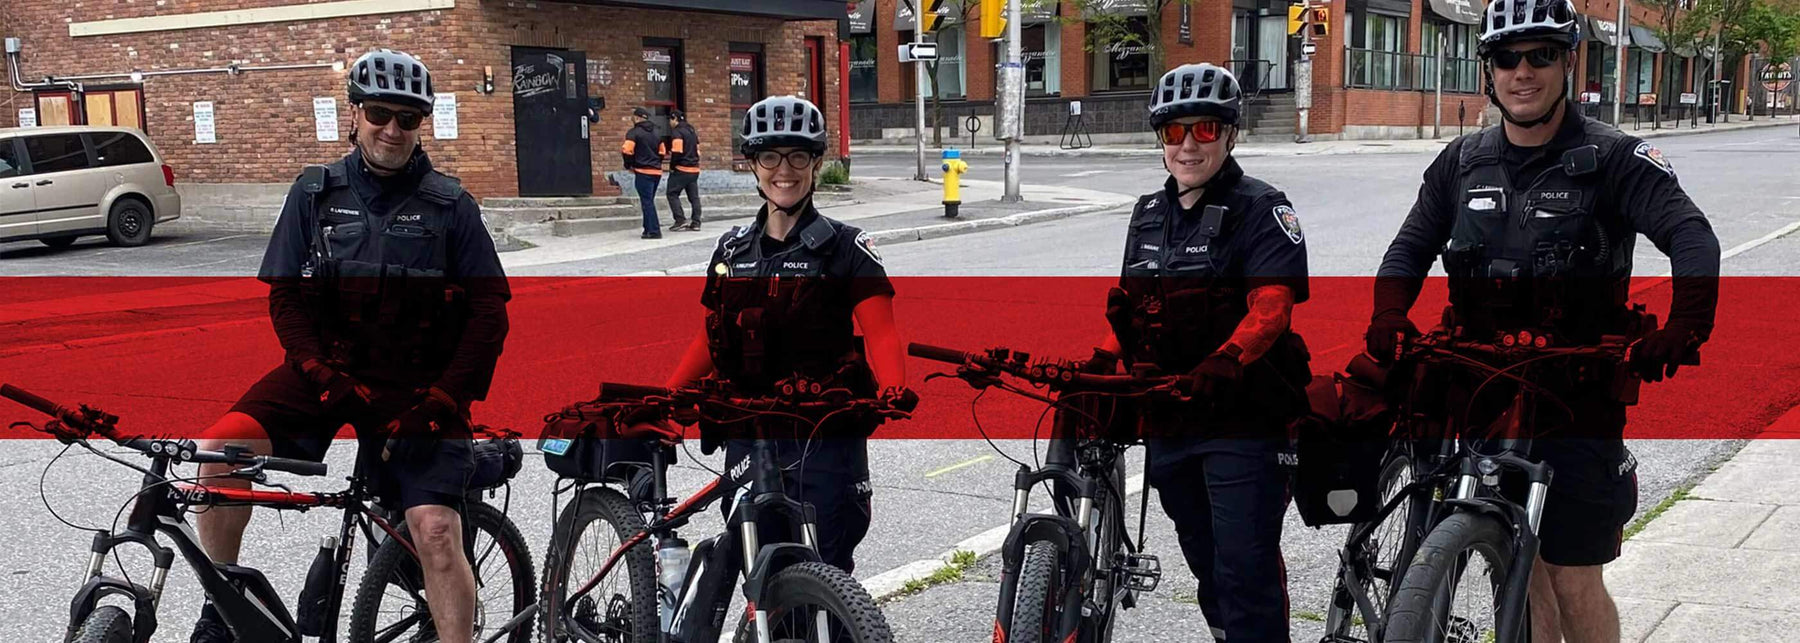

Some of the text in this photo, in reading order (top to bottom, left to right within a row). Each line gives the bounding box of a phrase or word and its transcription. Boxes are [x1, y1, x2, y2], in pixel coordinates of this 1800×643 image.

[515, 64, 535, 75] THE
[513, 71, 561, 90] RAINBOW
[1540, 192, 1569, 200] POLICE
[397, 214, 421, 222] POLICE
[1185, 245, 1208, 253] POLIC
[783, 262, 808, 270] POLICE
[730, 454, 751, 482] POLICE
[338, 513, 359, 585] POLICE
